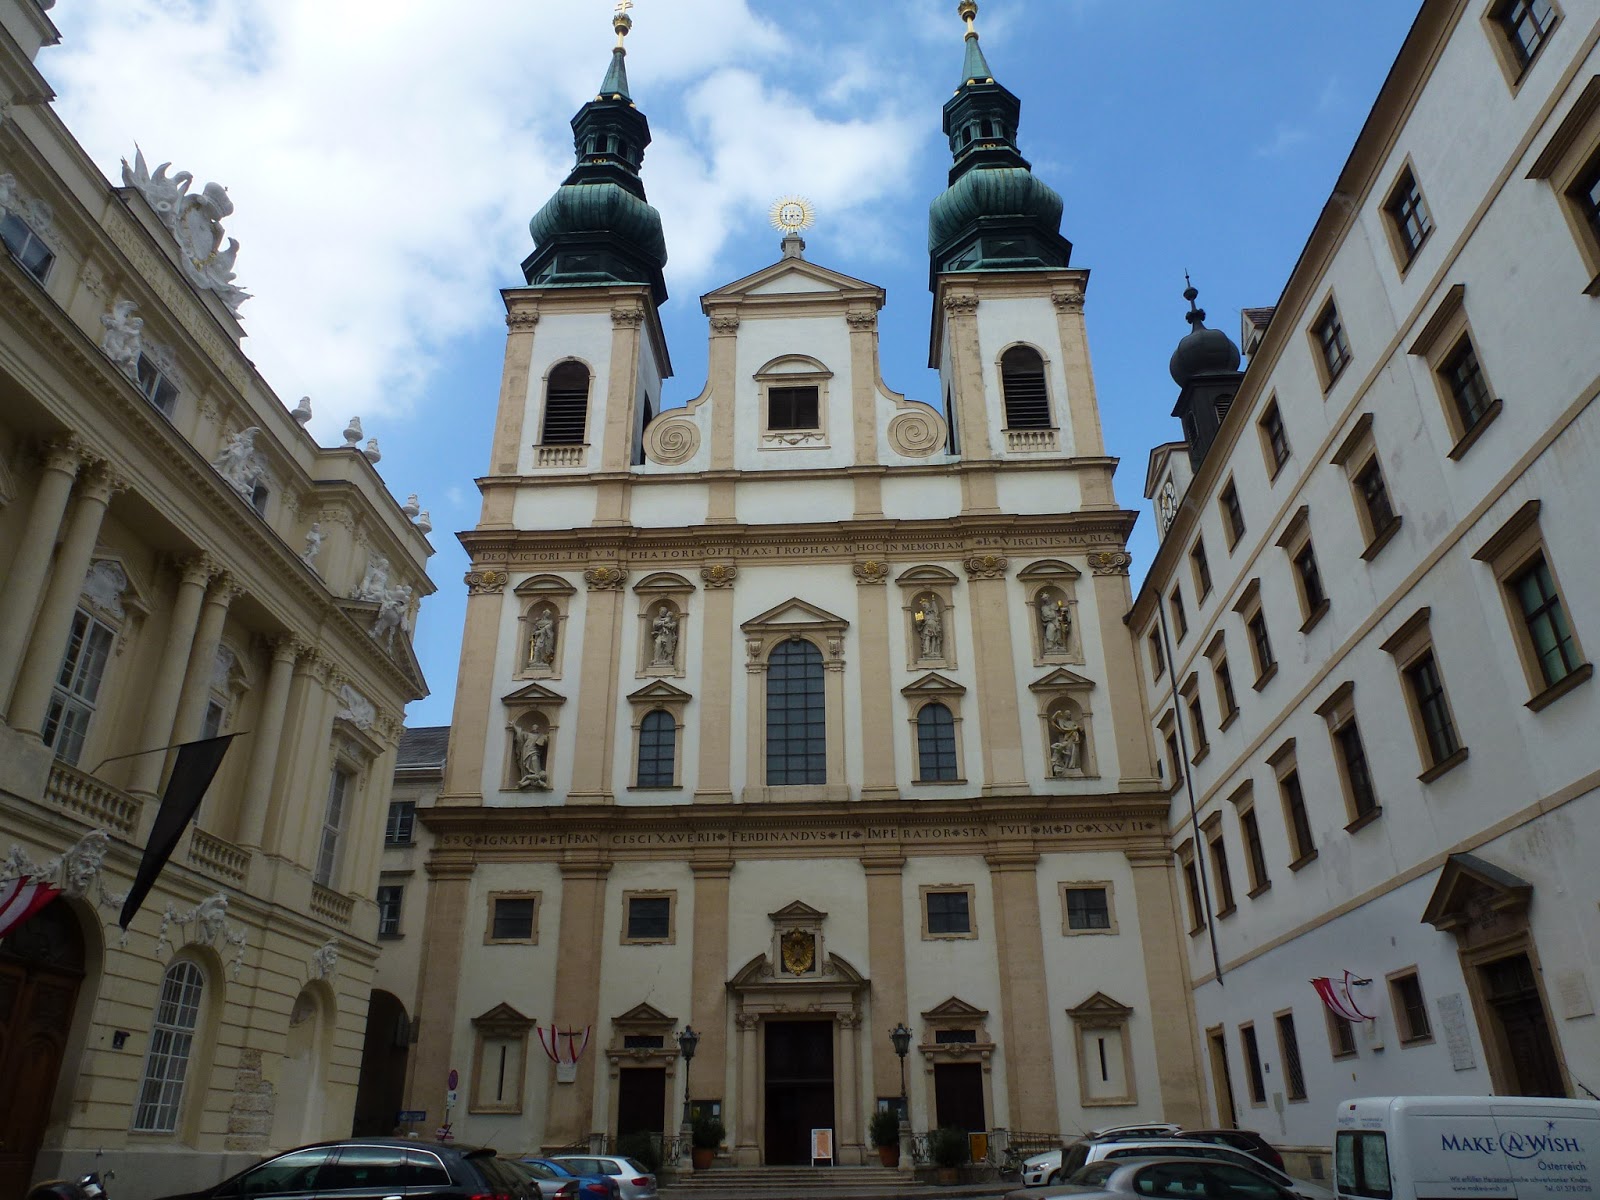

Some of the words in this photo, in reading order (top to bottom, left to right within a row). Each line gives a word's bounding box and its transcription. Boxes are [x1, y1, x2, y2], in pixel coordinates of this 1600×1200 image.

[482, 552, 507, 561] DEO
[857, 542, 883, 551] HOC
[901, 541, 964, 552] MEMORIAM
[549, 835, 565, 845] ET
[1538, 1159, 1586, 1171] Österreich
